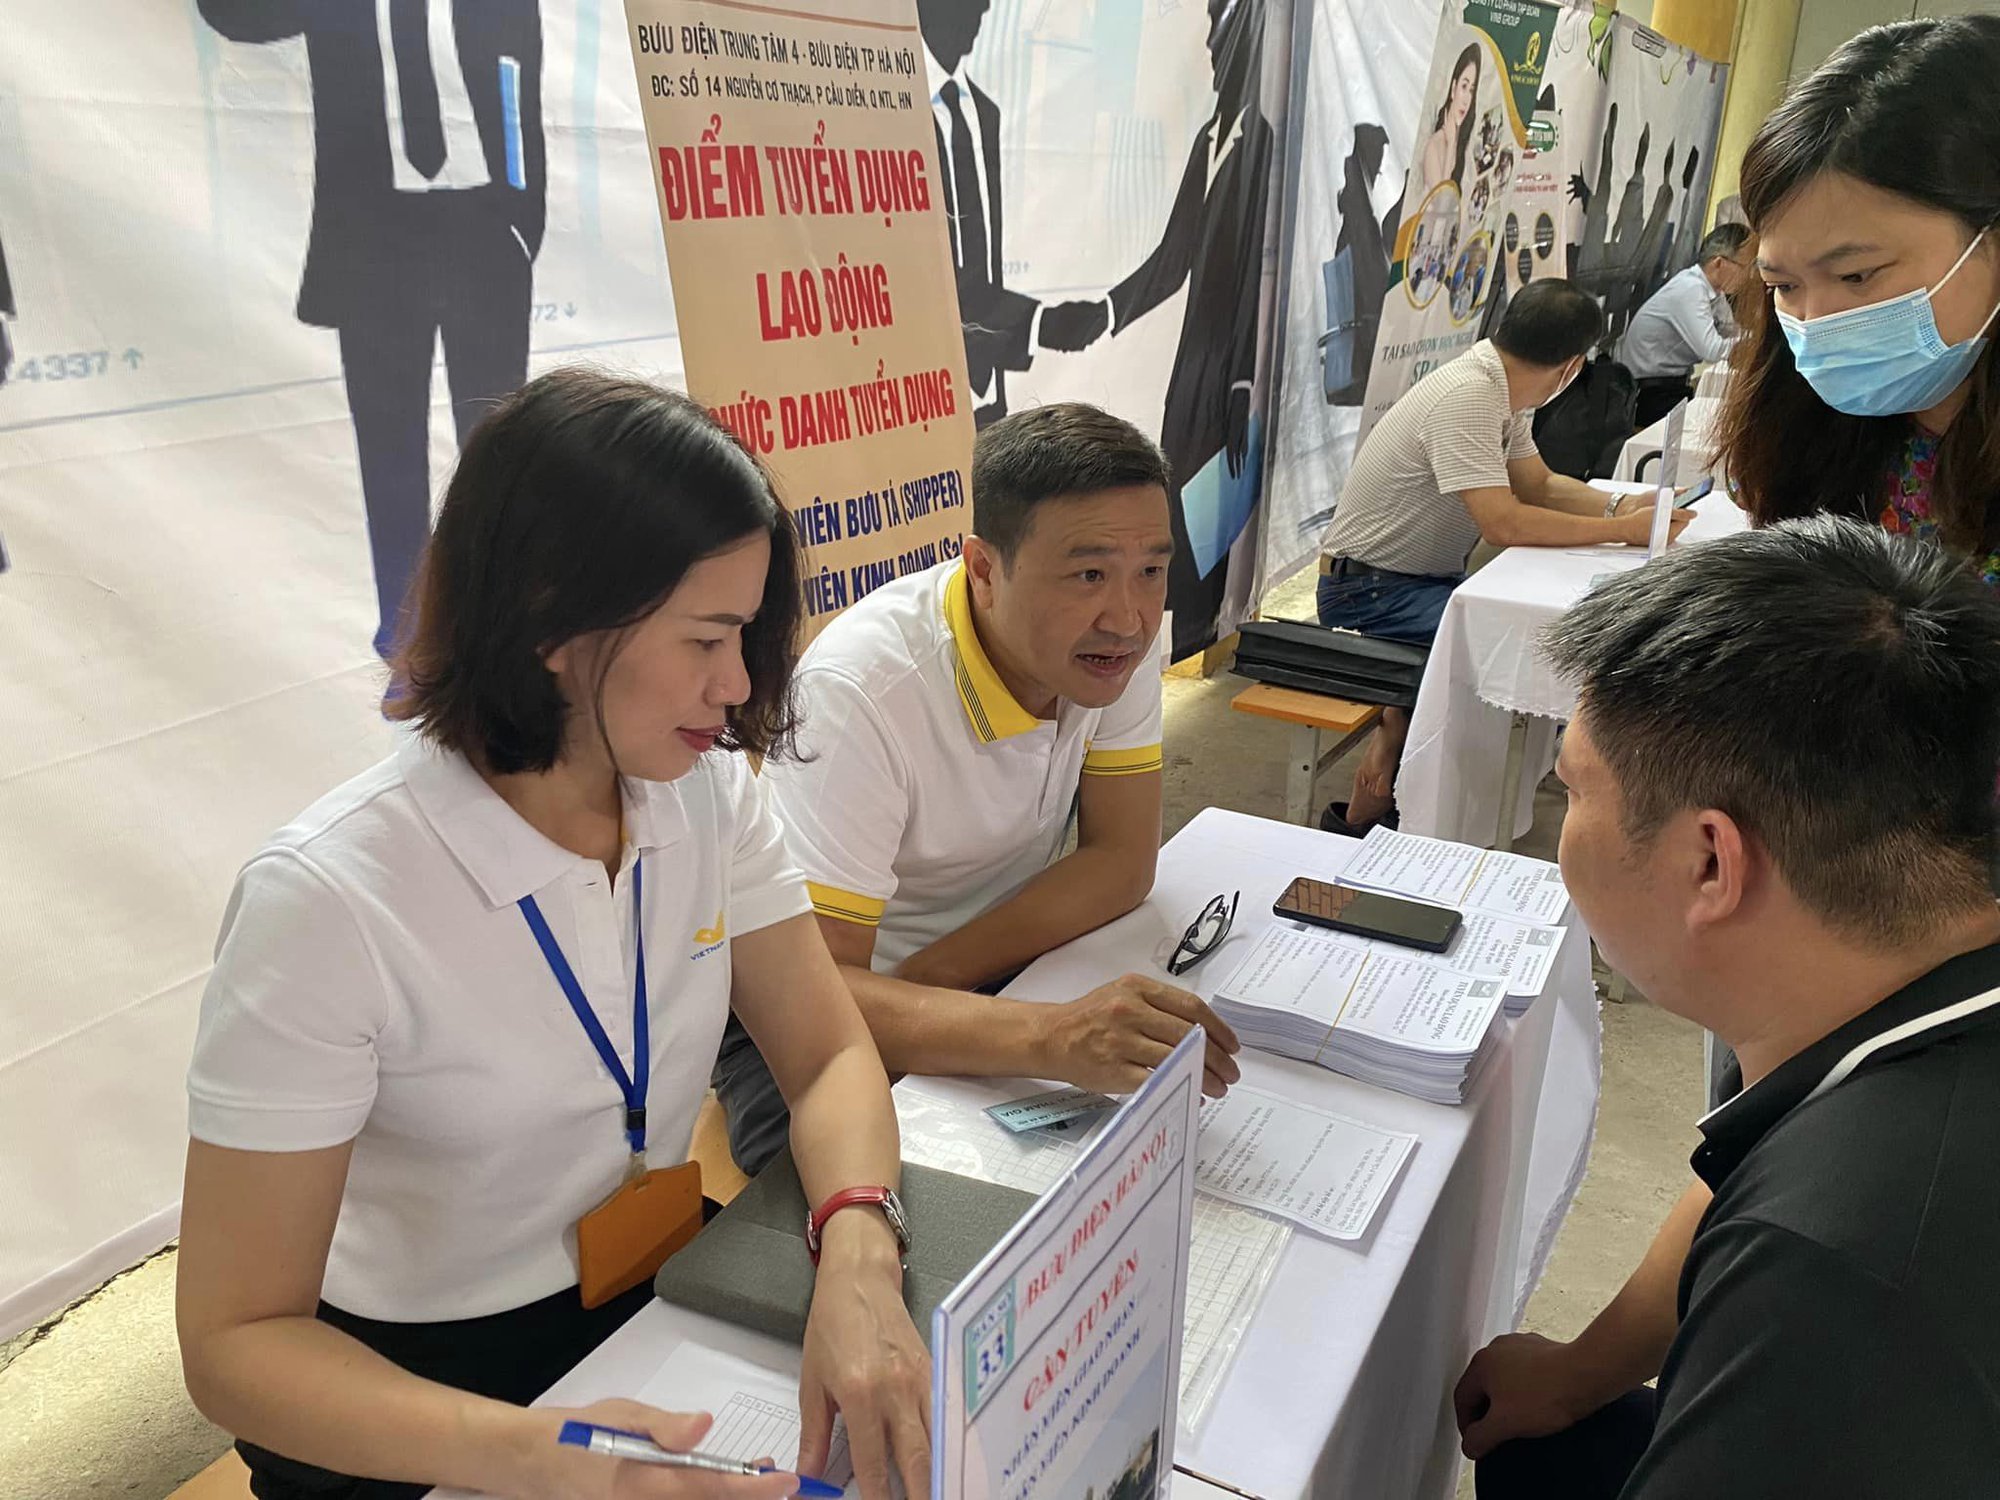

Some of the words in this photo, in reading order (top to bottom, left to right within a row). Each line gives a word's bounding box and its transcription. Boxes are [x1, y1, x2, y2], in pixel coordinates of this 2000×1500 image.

[638, 22, 674, 54] BƯU
[681, 21, 719, 60] ĐIỆN
[720, 28, 760, 60] TRUNG
[761, 32, 789, 63] TÂM
[792, 40, 799, 64] 4
[808, 40, 832, 68] BƯU
[834, 41, 859, 75] ĐIỆN
[861, 47, 875, 72] TP
[878, 46, 893, 74] HÀ
[895, 47, 916, 79] NỘI
[651, 75, 674, 97] ĐC:
[680, 67, 699, 97] SỐ
[705, 75, 722, 97] 14
[780, 81, 816, 107] THẠCH,
[816, 85, 823, 104] P
[870, 89, 878, 109] Q
[898, 90, 913, 110] HN
[659, 113, 765, 221] ĐIỂM
[765, 119, 854, 216] TUYỂN
[855, 149, 931, 227] DỤNG
[756, 267, 823, 342] LAO
[821, 252, 894, 346] ĐỘNG
[779, 387, 851, 450] DANH
[849, 358, 904, 437] TUYỂN
[903, 368, 956, 433] DỤNG
[794, 496, 842, 549] VIÊN
[845, 491, 883, 538] BƯU
[882, 479, 902, 528] TÁ
[900, 469, 964, 526] (SHIPPER)
[803, 566, 848, 617] VIÊN
[851, 558, 896, 603] KINH
[999, 1107, 1022, 1119] GIA
[978, 1332, 1005, 1391] 33
